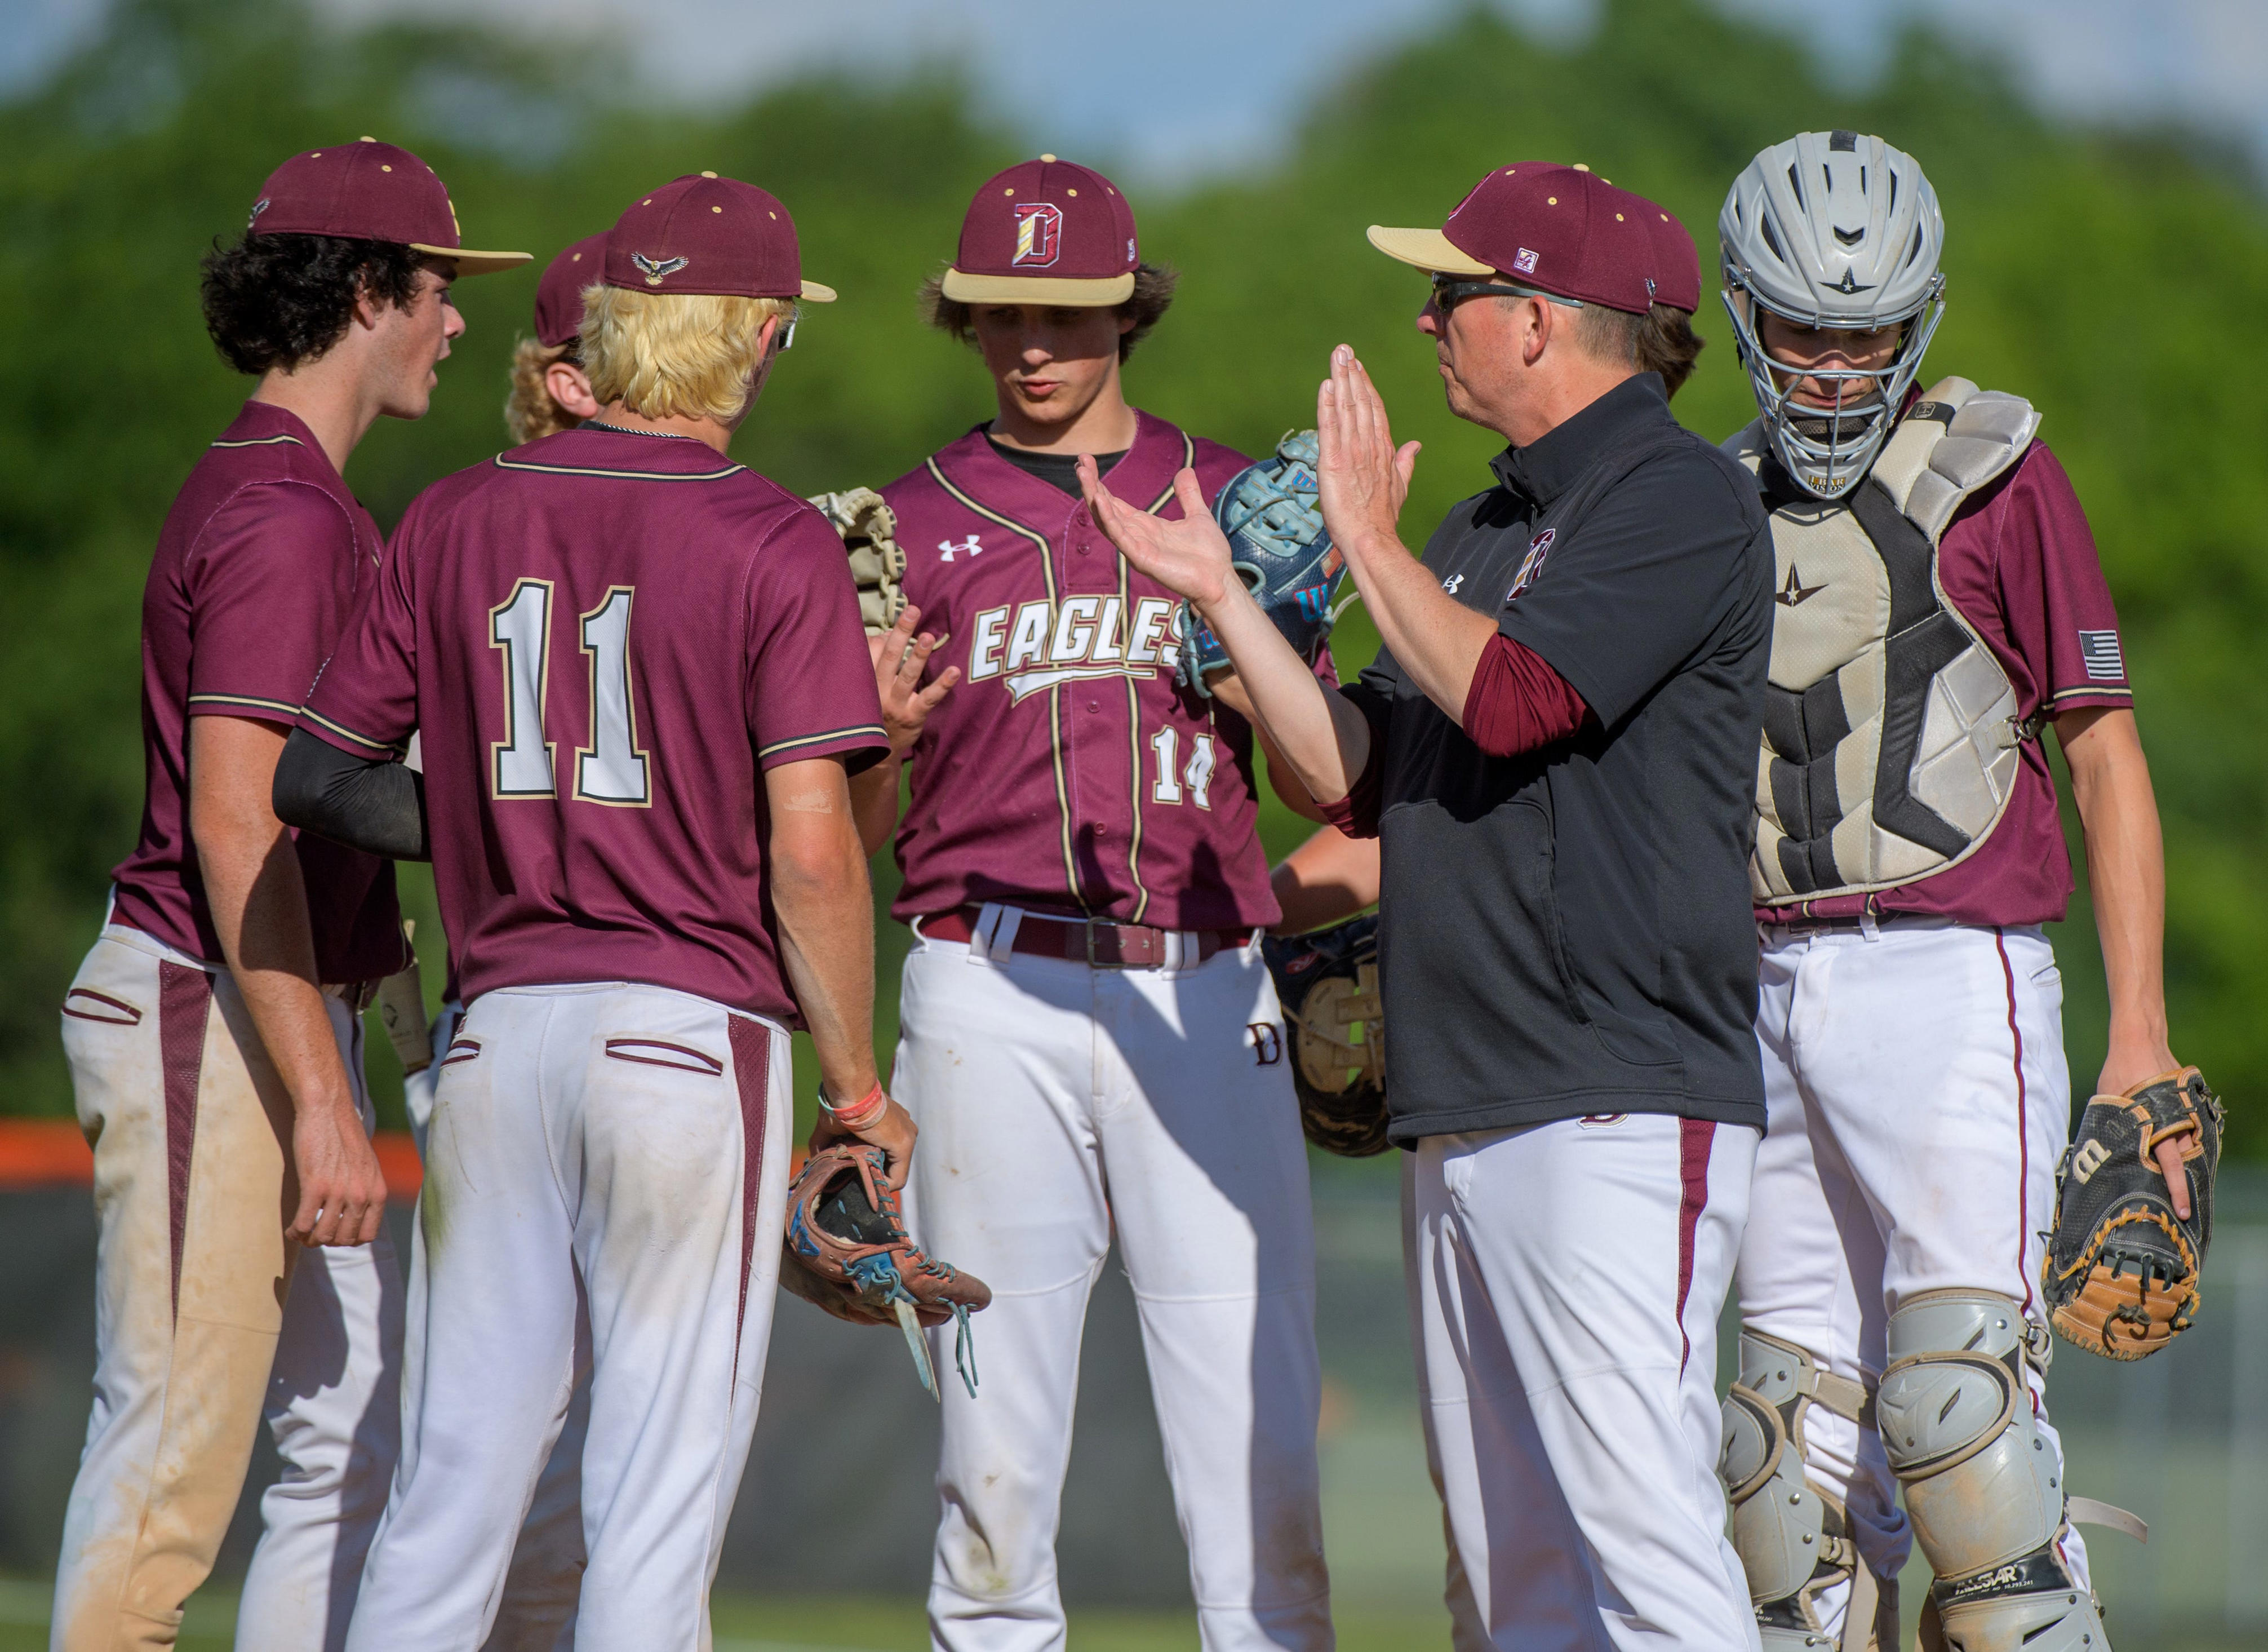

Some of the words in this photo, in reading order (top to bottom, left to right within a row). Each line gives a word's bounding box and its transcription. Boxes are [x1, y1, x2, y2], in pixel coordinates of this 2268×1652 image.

[1013, 202, 1063, 268] D
[1809, 482, 1844, 492] VISON
[1293, 582, 1328, 625] W
[968, 594, 1183, 683] EAGLES
[489, 577, 652, 808] 11
[1151, 724, 1217, 811] 14
[1246, 1022, 1283, 1067] D
